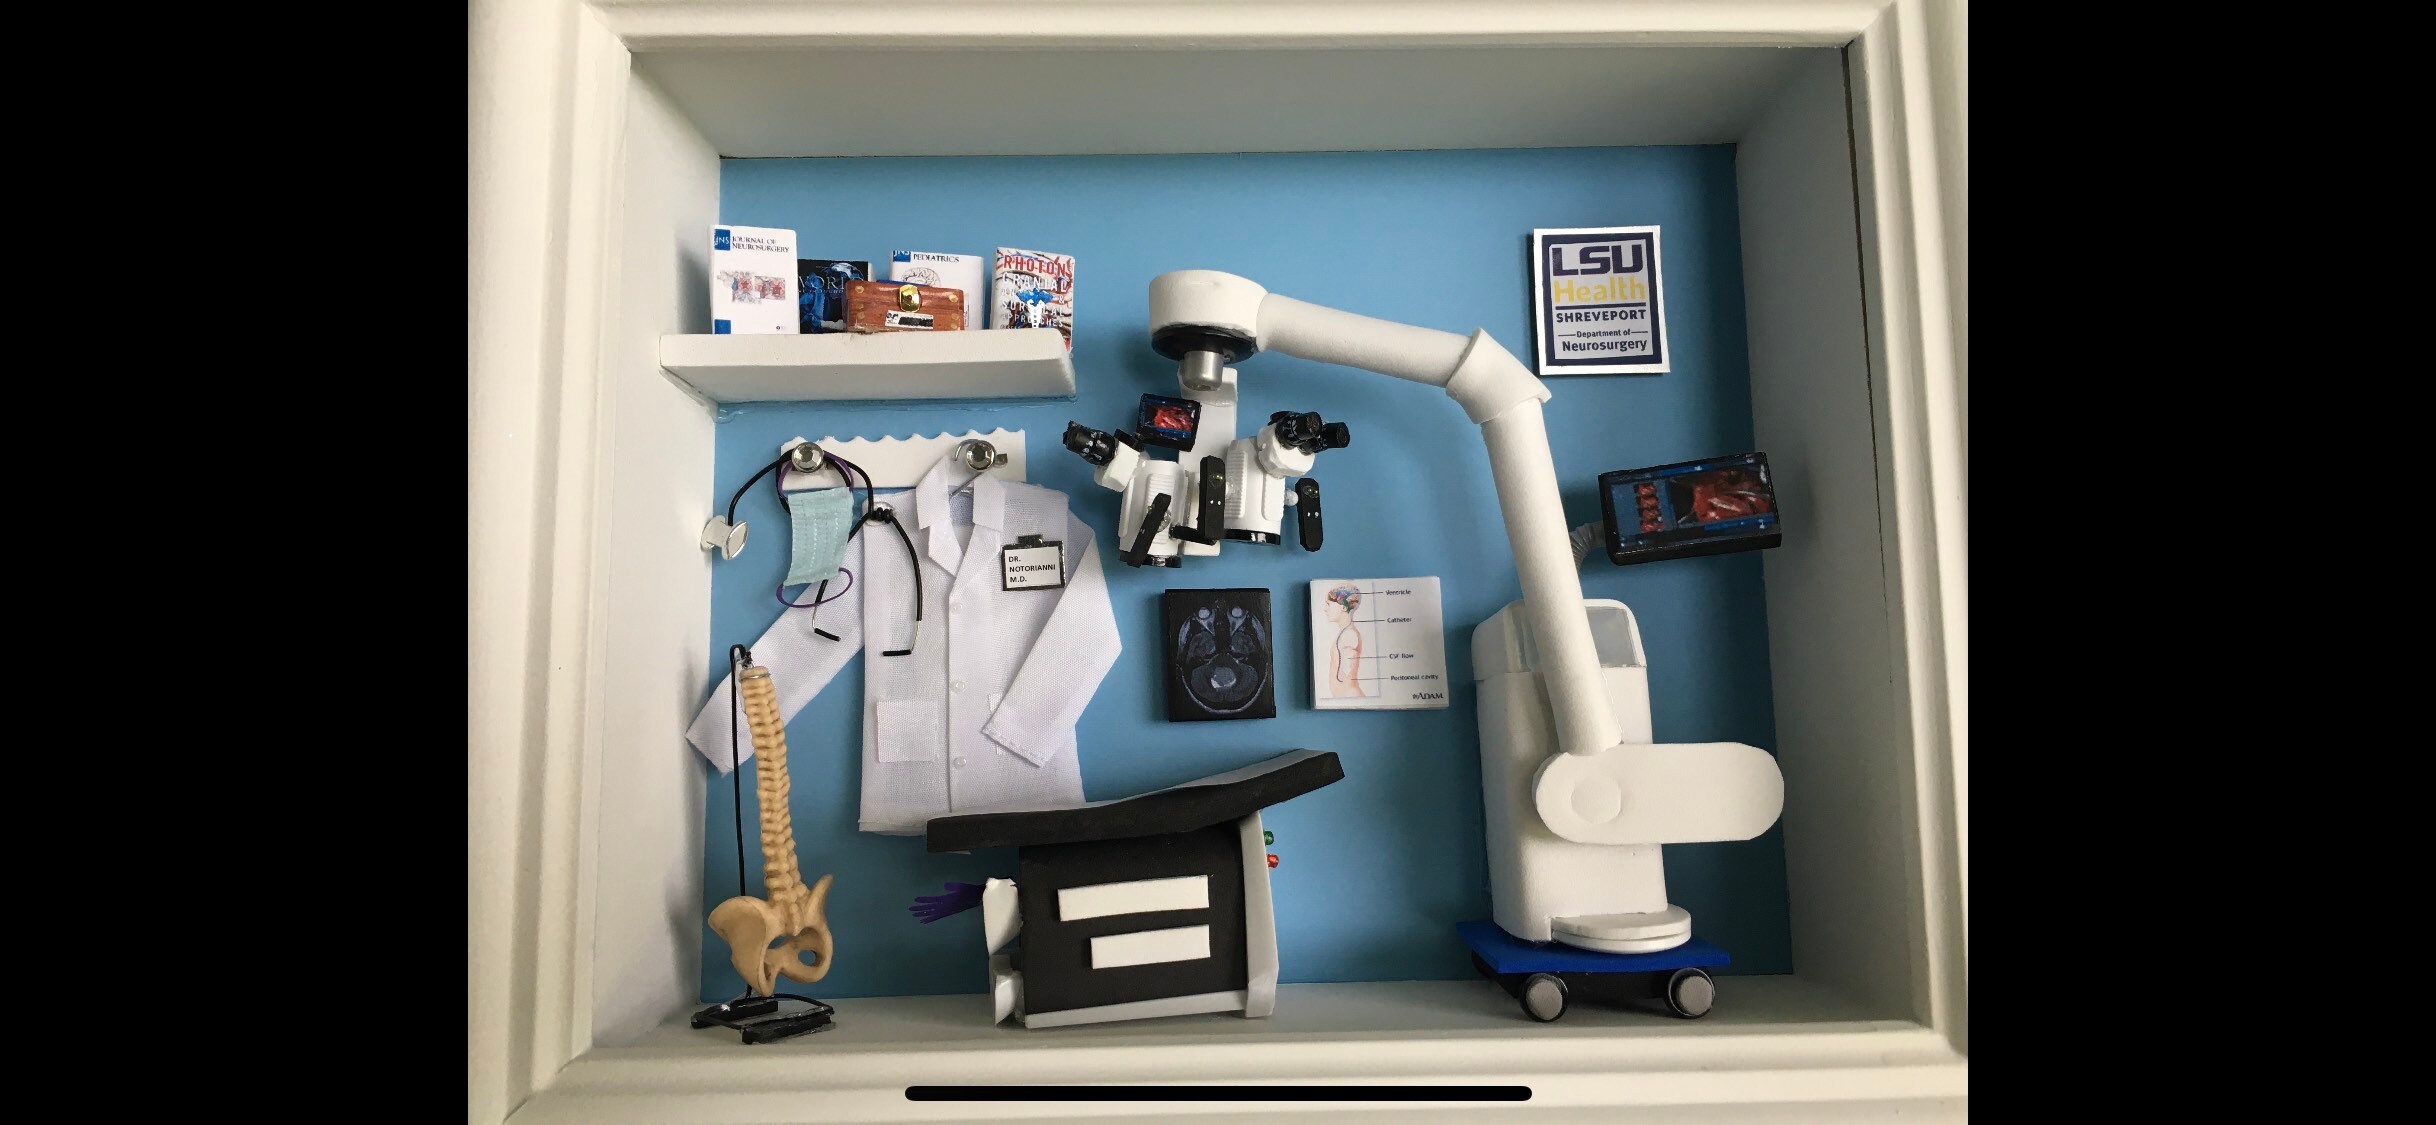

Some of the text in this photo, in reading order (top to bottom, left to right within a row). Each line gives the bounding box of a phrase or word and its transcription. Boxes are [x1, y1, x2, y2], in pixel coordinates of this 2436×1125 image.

[732, 236, 764, 244] JOURNAL
[732, 243, 790, 253] NEUROSURGERY
[913, 254, 960, 263] PEDIATRICS
[1552, 244, 1643, 276] LSU
[1002, 272, 1067, 293] CRANIAL
[1554, 275, 1646, 304] Health
[1556, 310, 1646, 323] SHREVEPORT
[1576, 331, 1621, 339] Department
[1562, 340, 1648, 352] Neurosurgery
[1009, 564, 1056, 573] NOTORIANNI
